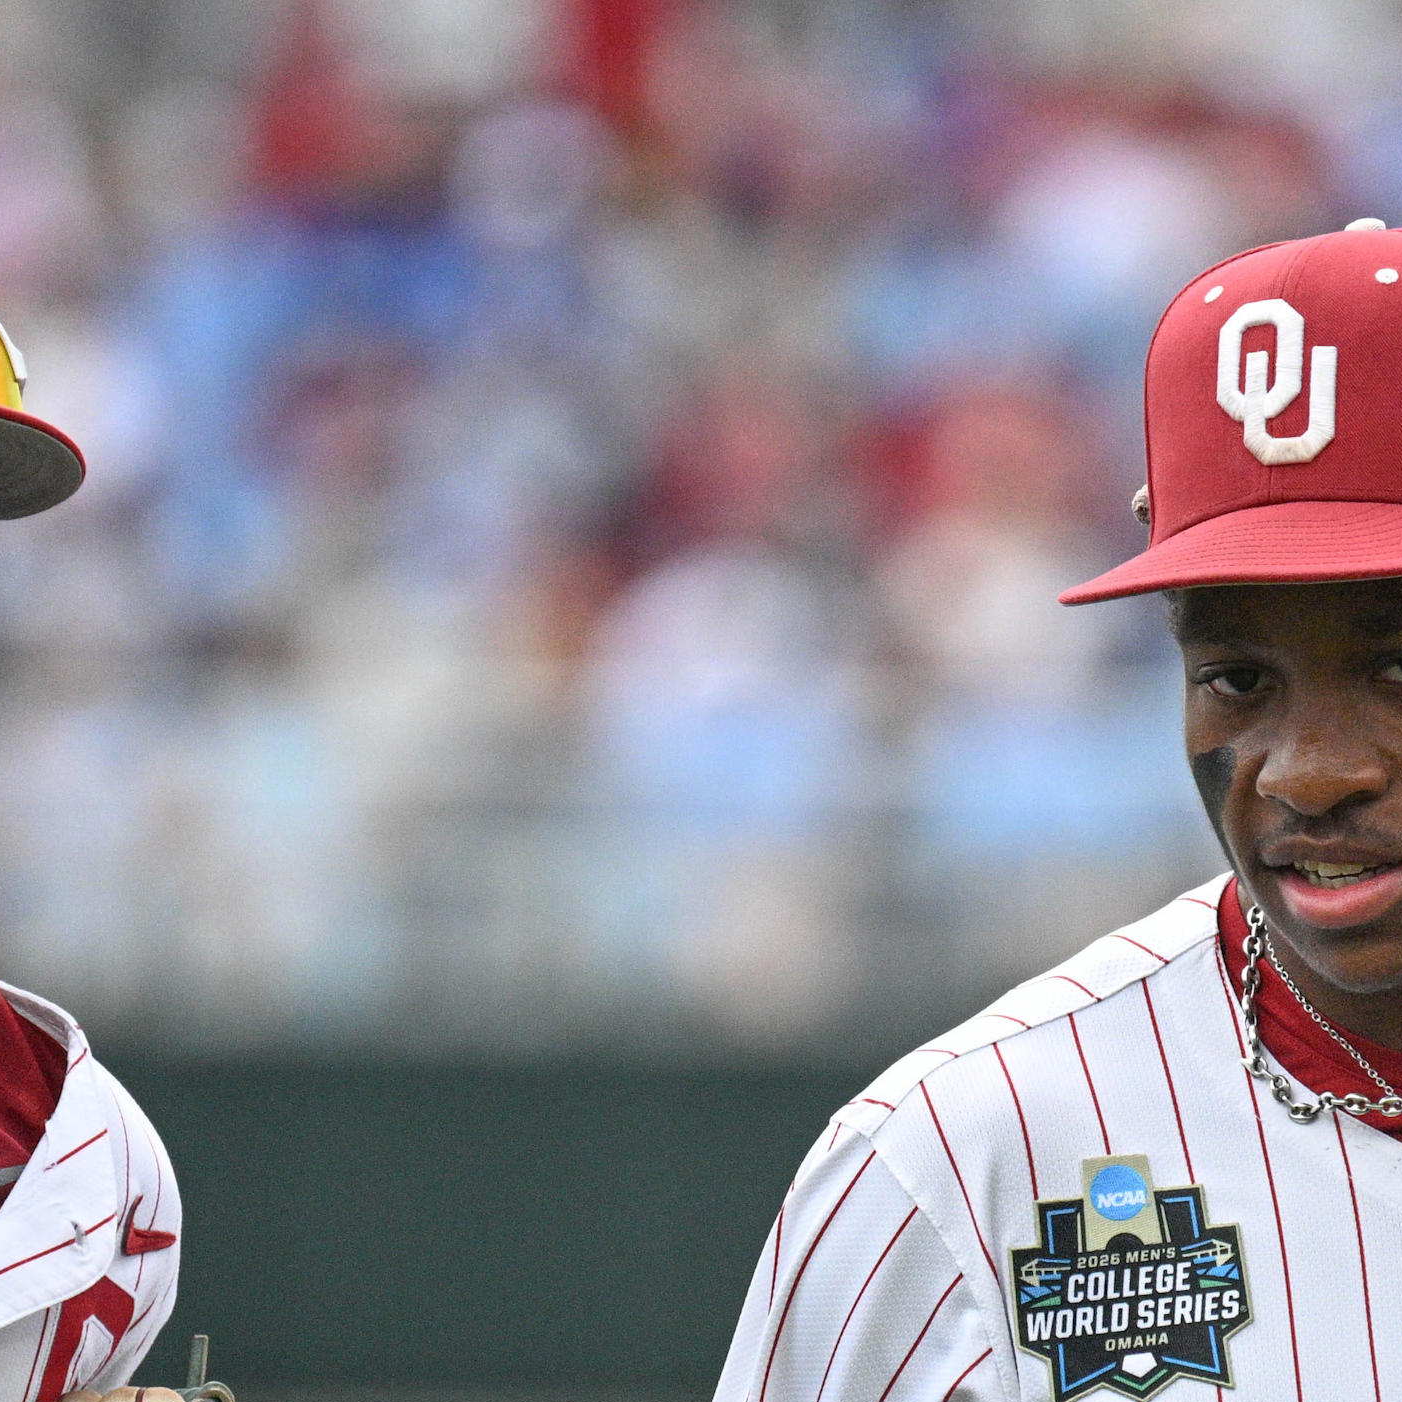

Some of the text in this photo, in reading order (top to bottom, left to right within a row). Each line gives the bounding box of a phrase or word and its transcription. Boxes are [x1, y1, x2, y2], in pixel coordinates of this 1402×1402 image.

[1216, 298, 1338, 466] OU
[1097, 1191, 1148, 1209] NCAA
[1077, 1247, 1176, 1269] 2026 MEN'S
[1067, 1261, 1192, 1304] COLLEGE
[1026, 1290, 1240, 1342] WORLD SERIES
[1105, 1332, 1169, 1351] OMAHA
